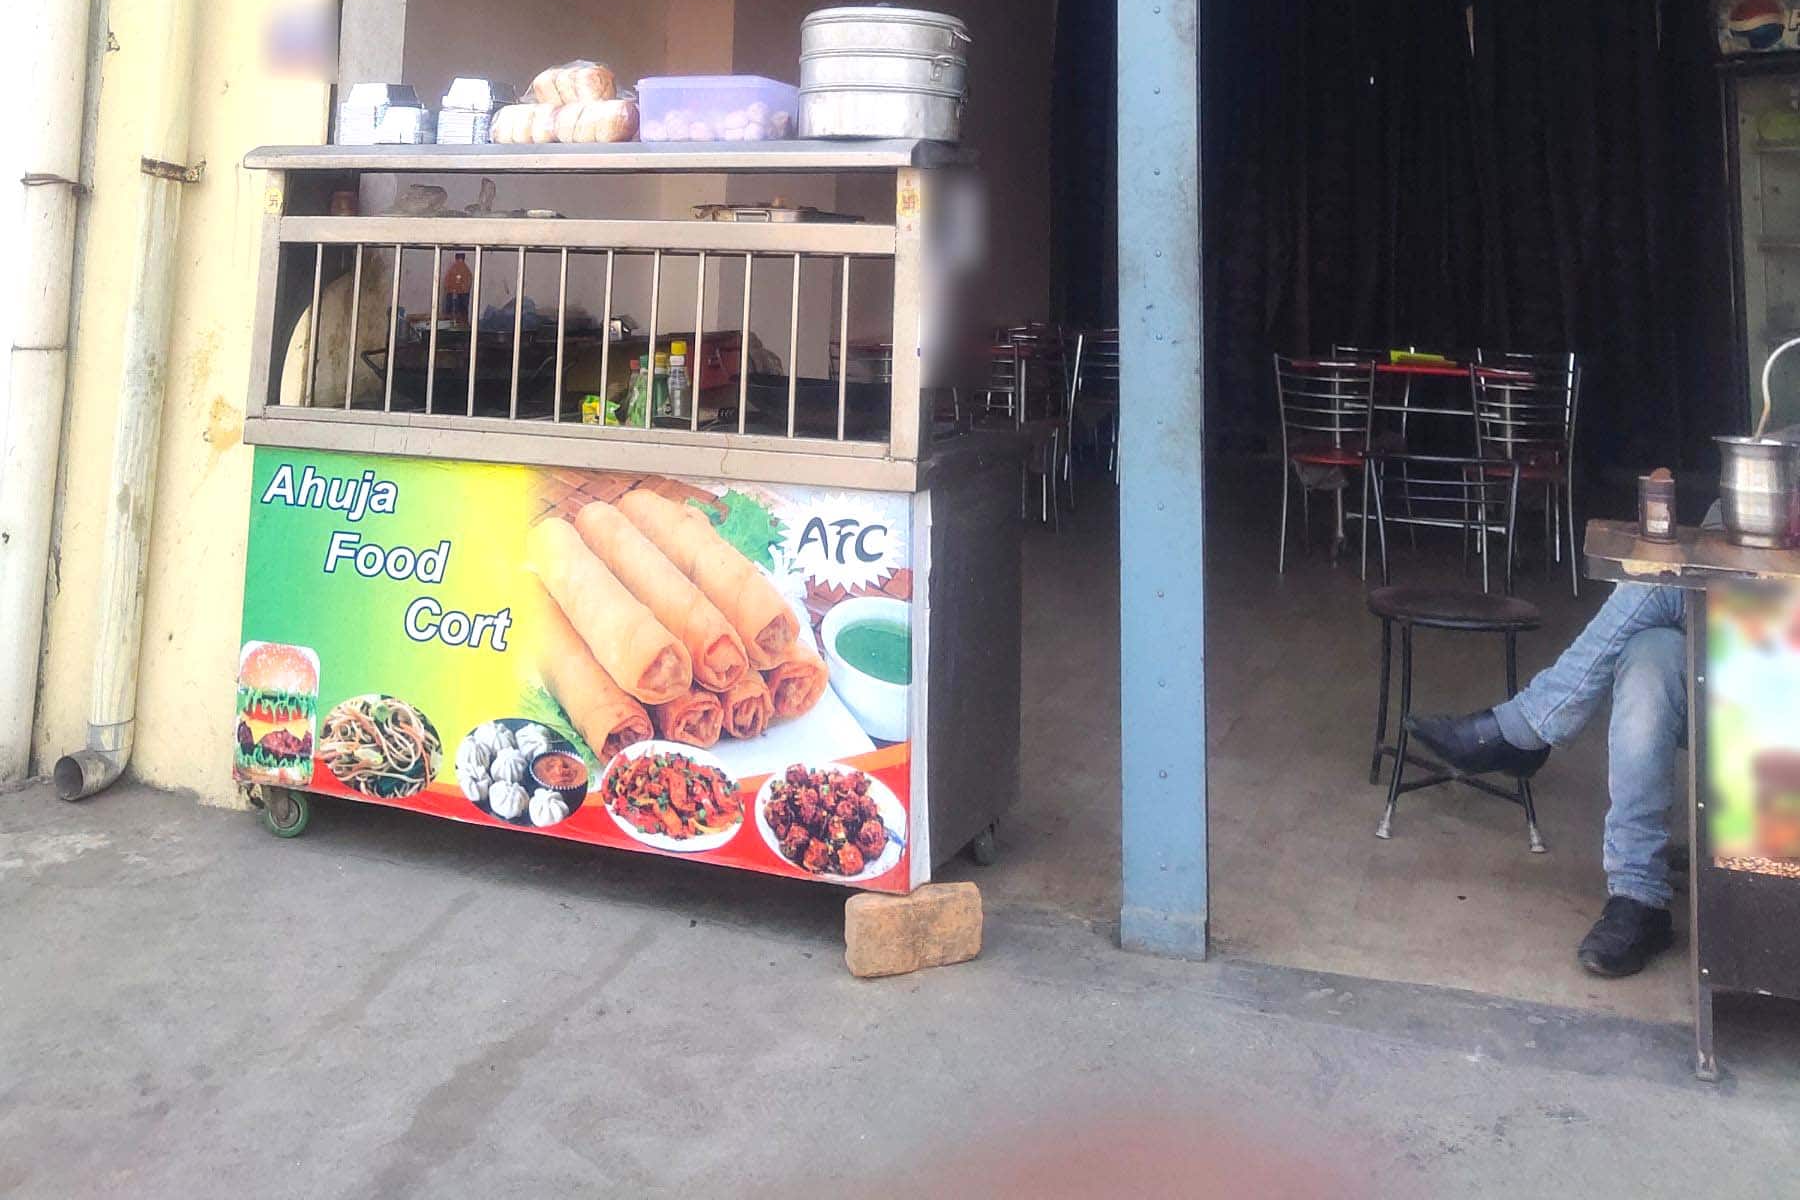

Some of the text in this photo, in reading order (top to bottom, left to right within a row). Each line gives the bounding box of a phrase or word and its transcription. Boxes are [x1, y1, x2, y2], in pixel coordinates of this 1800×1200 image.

[261, 464, 398, 522] Ahuja
[323, 531, 451, 583] Food
[797, 516, 887, 564] AFC
[404, 597, 512, 651] Cort
